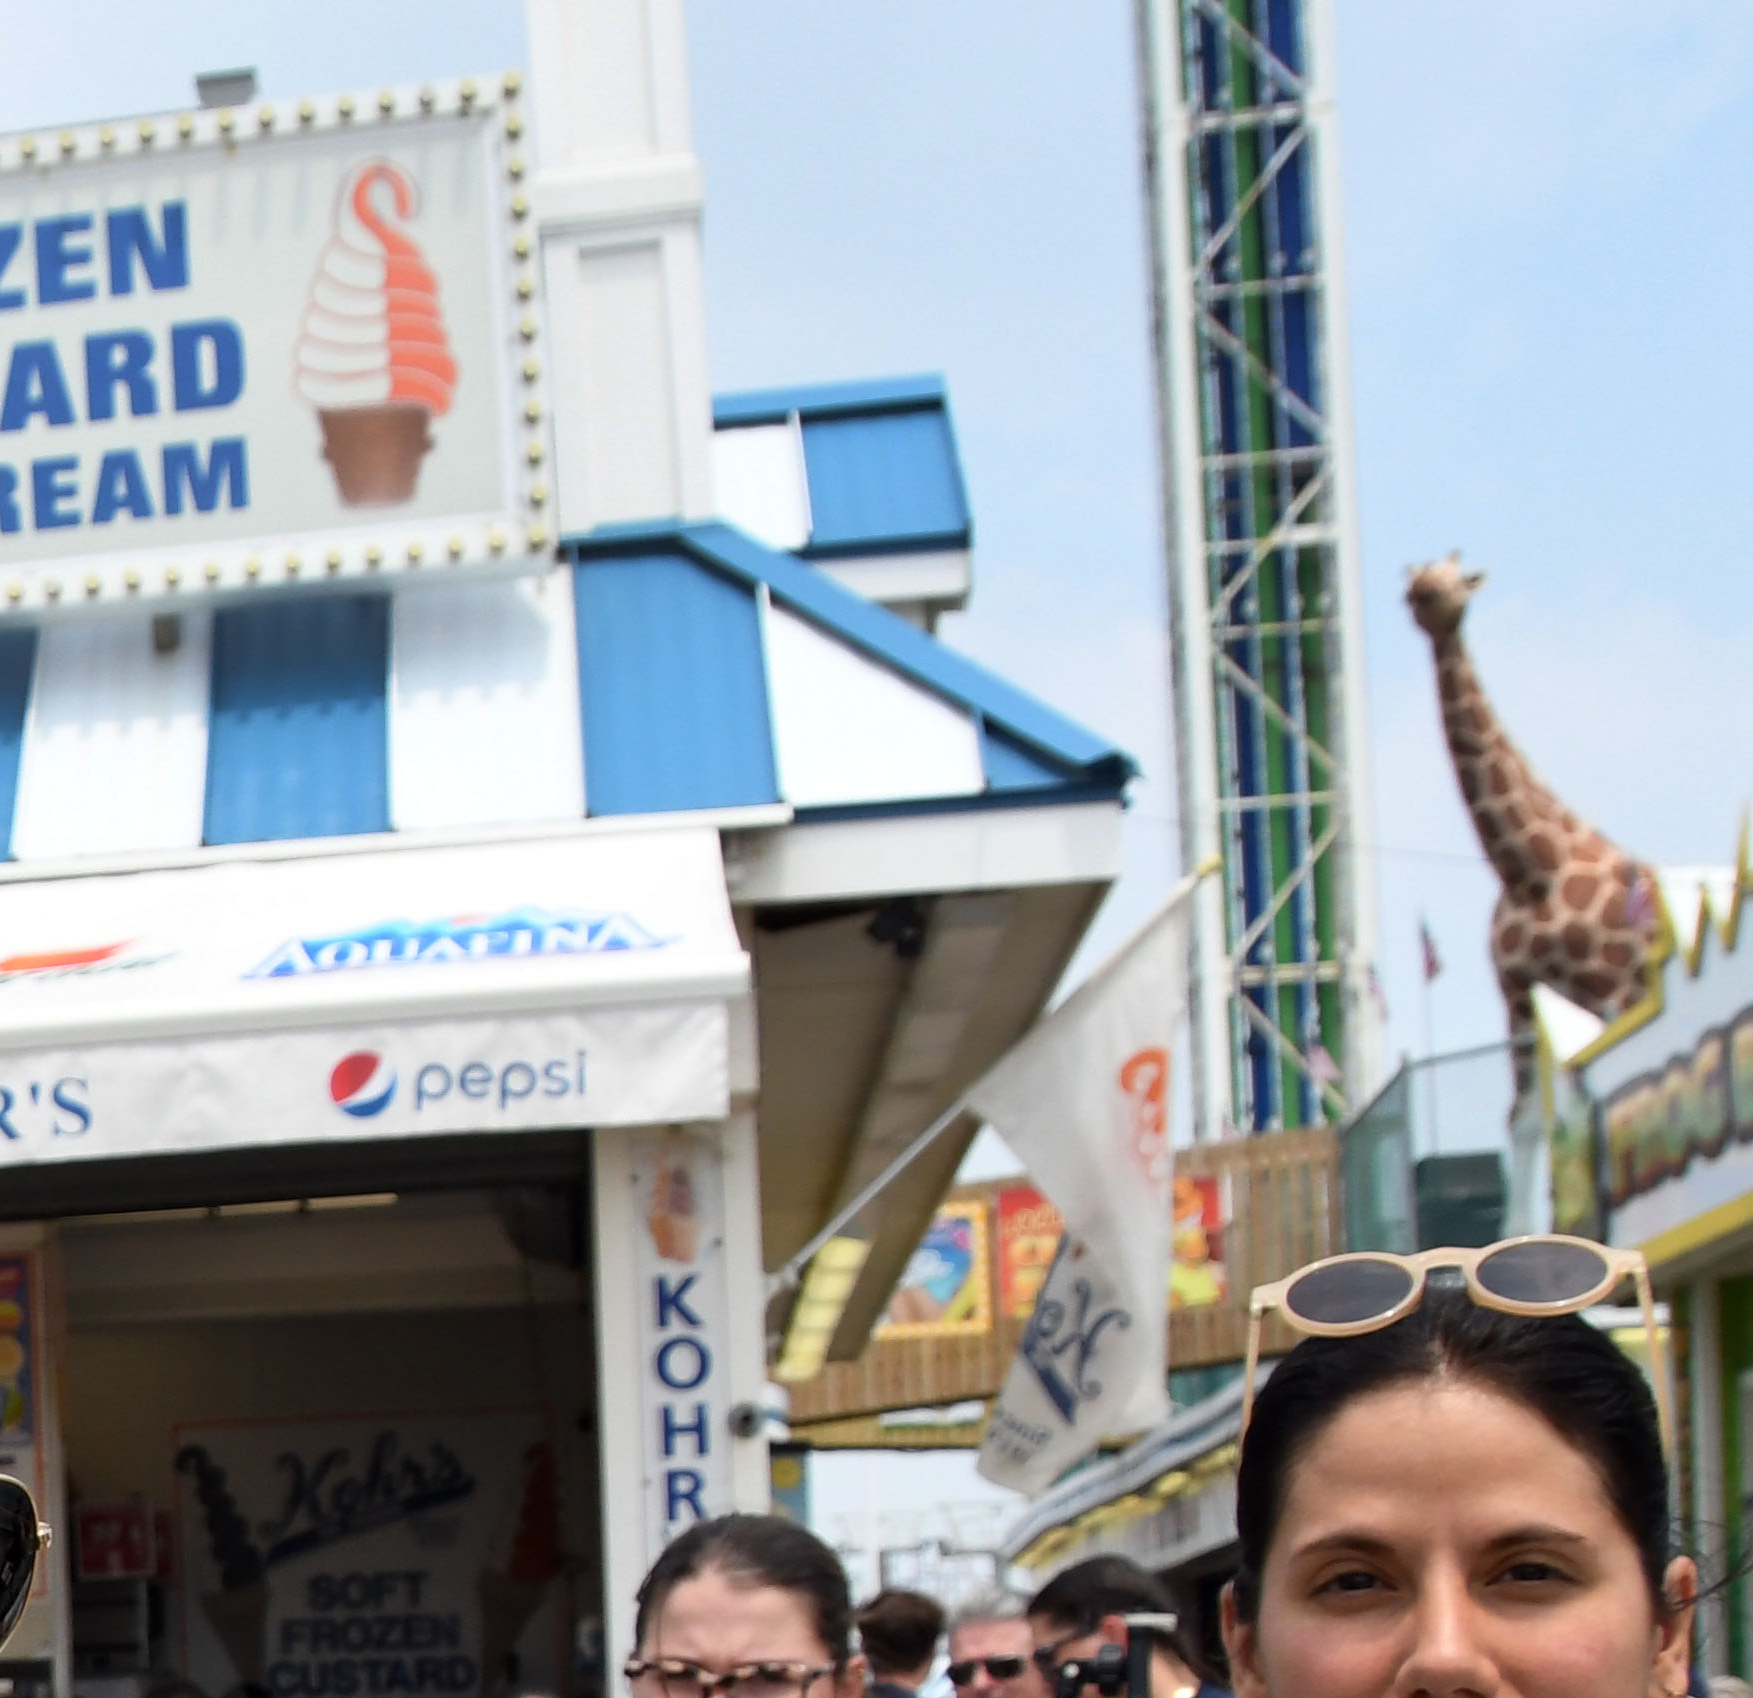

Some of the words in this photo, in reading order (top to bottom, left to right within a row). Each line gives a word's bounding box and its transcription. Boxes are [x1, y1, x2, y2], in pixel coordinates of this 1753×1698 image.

[415, 1049, 588, 1112] pepsi
[655, 1273, 713, 1522] KOHR
[307, 1571, 431, 1610] SOFT
[281, 1614, 460, 1654] FROZEN
[267, 1656, 477, 1698] CUSTARD
